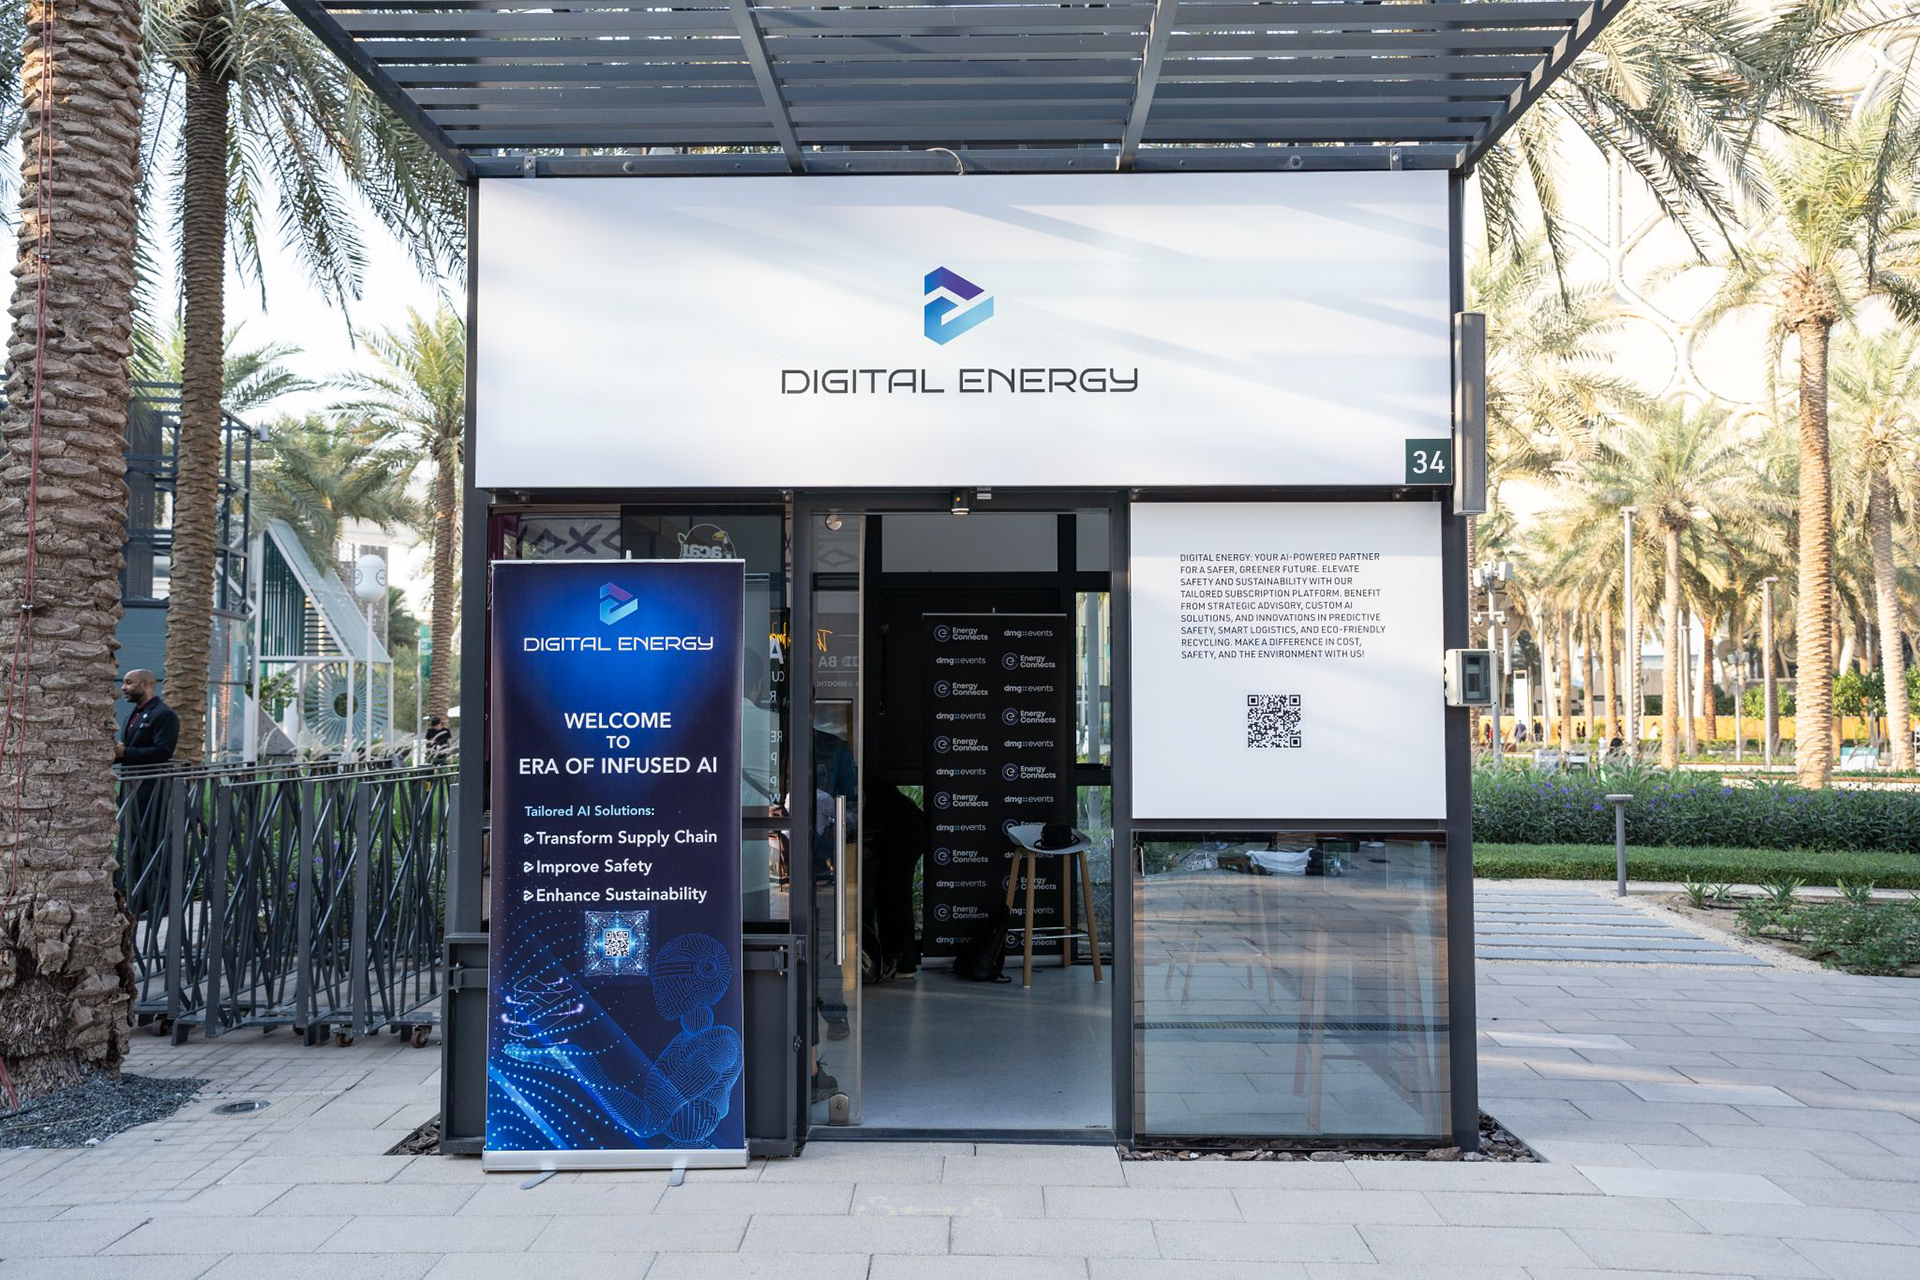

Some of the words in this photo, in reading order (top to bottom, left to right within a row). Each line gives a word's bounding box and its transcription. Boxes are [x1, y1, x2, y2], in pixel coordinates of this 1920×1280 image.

[781, 369, 945, 394] DIGITAL
[959, 368, 1138, 393] ENERGY
[1412, 450, 1445, 473] 34
[1180, 554, 1213, 562] DIGITAL
[1216, 553, 1253, 561] ENERGY:
[1254, 553, 1278, 561] YOUR
[1280, 553, 1337, 561] AI-POWERED
[1180, 566, 1197, 574] FOR
[1199, 566, 1205, 574] A
[1207, 566, 1237, 575] SAFER,
[1239, 565, 1280, 573] GREENER
[1283, 565, 1319, 573] FUTURE.
[1322, 565, 1360, 573] ELEVATE
[1180, 578, 1213, 586] SAFETY
[1215, 578, 1233, 586] AND
[1236, 577, 1307, 585] SUSTAINABILITY
[1308, 577, 1332, 585] WITH
[1181, 590, 1223, 598] TAILORED
[1225, 589, 1289, 597] SUBSCRIPTION
[1292, 589, 1342, 597] PLATFORM.
[1344, 589, 1381, 597] BENEFIT
[1181, 602, 1205, 610] FROM
[1208, 602, 1256, 610] STRATEGIC
[1258, 601, 1303, 611] ADVISORY,
[1305, 601, 1342, 610] CUSTOM
[1181, 614, 1234, 623] SOLUTIONS,
[1235, 614, 1254, 622] AND
[1256, 614, 1315, 622] INNOVATIONS
[1329, 613, 1381, 621] PREDICTIVE
[952, 627, 978, 635] Energy
[1181, 626, 1216, 635] SAFETY,
[1218, 626, 1248, 634] SMART
[1250, 626, 1299, 635] LOGISTICS,
[1300, 626, 1319, 634] AND
[1321, 625, 1386, 634] ECO-FRIENDLY
[523, 636, 611, 652] DIGITAL
[618, 636, 714, 651] ENERGY
[1181, 638, 1232, 646] RECYCLING.
[1235, 638, 1259, 646] MAKE
[1261, 638, 1267, 646] A
[1269, 638, 1323, 646] DIFFERENCE
[1336, 637, 1362, 647] COST,
[1020, 655, 1046, 663] Energy
[1181, 650, 1216, 660] SAFETY,
[1218, 650, 1237, 658] AND
[1239, 650, 1256, 658] THE
[1258, 650, 1322, 658] ENVIRONMENT
[1324, 650, 1348, 658] WITH
[1350, 649, 1365, 657] US!
[952, 682, 978, 690] Energy
[1020, 710, 1046, 718] Energy
[564, 712, 672, 729] WELCOME
[606, 735, 630, 749] TO
[952, 738, 978, 746] Energy
[519, 758, 559, 775] ERA
[565, 757, 595, 775] OF
[601, 756, 691, 774] INFUSED
[696, 756, 717, 773] AI
[1020, 766, 1046, 774] Energy
[952, 793, 978, 802] Energy
[524, 805, 573, 817] Tailored
[577, 805, 590, 816] AI
[594, 805, 655, 816] Solutions:
[536, 831, 613, 845] Transform
[617, 830, 669, 847] Supply
[674, 830, 717, 843] Chain
[952, 850, 978, 858] Energy
[536, 860, 599, 876] Improve
[604, 859, 653, 875] Safety
[536, 889, 600, 902] Enhance
[605, 887, 707, 903] Sustainability
[952, 905, 978, 913] Energy
